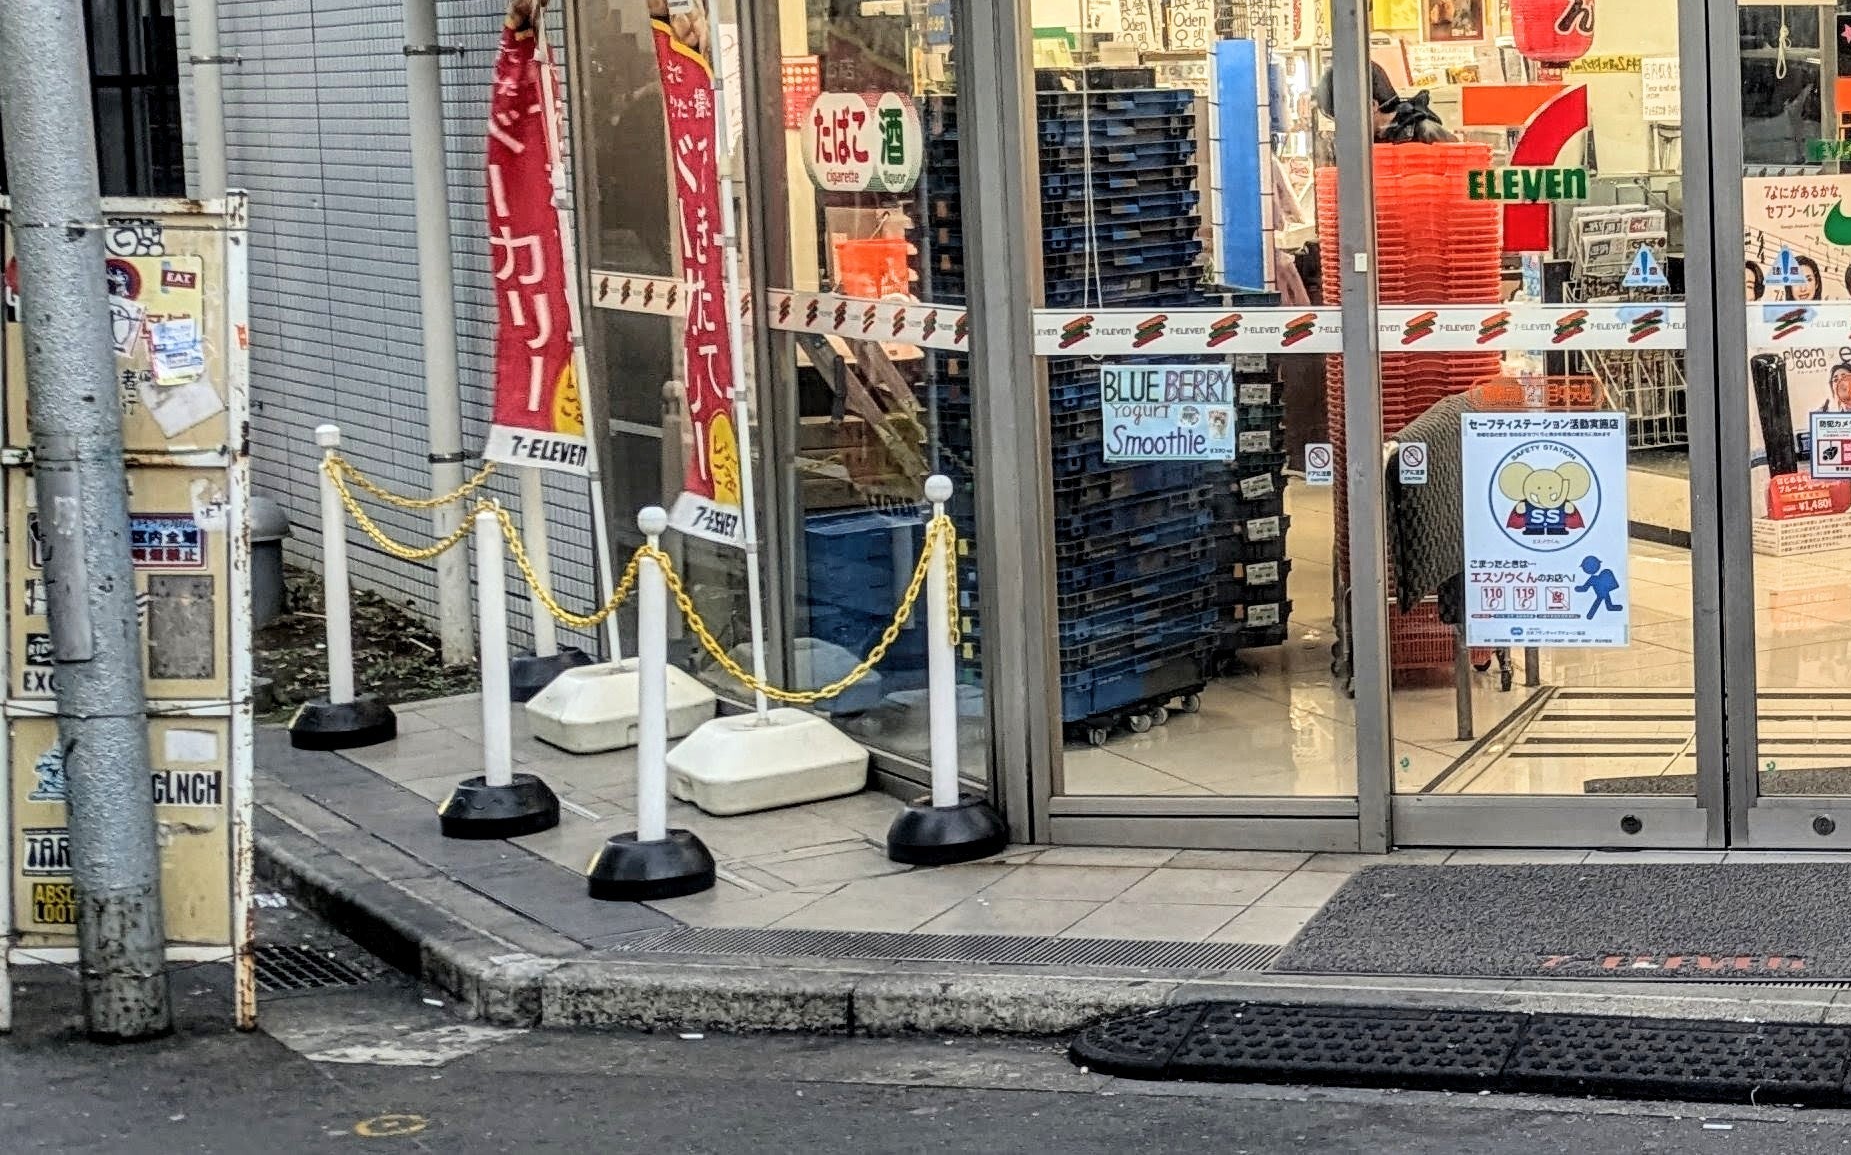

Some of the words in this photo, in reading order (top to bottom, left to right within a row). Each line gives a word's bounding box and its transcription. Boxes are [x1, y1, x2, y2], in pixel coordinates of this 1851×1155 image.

[1173, 12, 1206, 28] Oden
[815, 107, 869, 165] たばこ
[879, 107, 905, 165] 酒
[826, 170, 860, 184] cigarette
[1103, 370, 1159, 403] BLUE
[1164, 369, 1232, 403] BERRY
[1106, 424, 1206, 455] Smoothie
[1511, 445, 1541, 461] SAFETY
[1543, 444, 1577, 461] STATION
[1484, 588, 1503, 599] 110
[1516, 588, 1535, 599] 119
